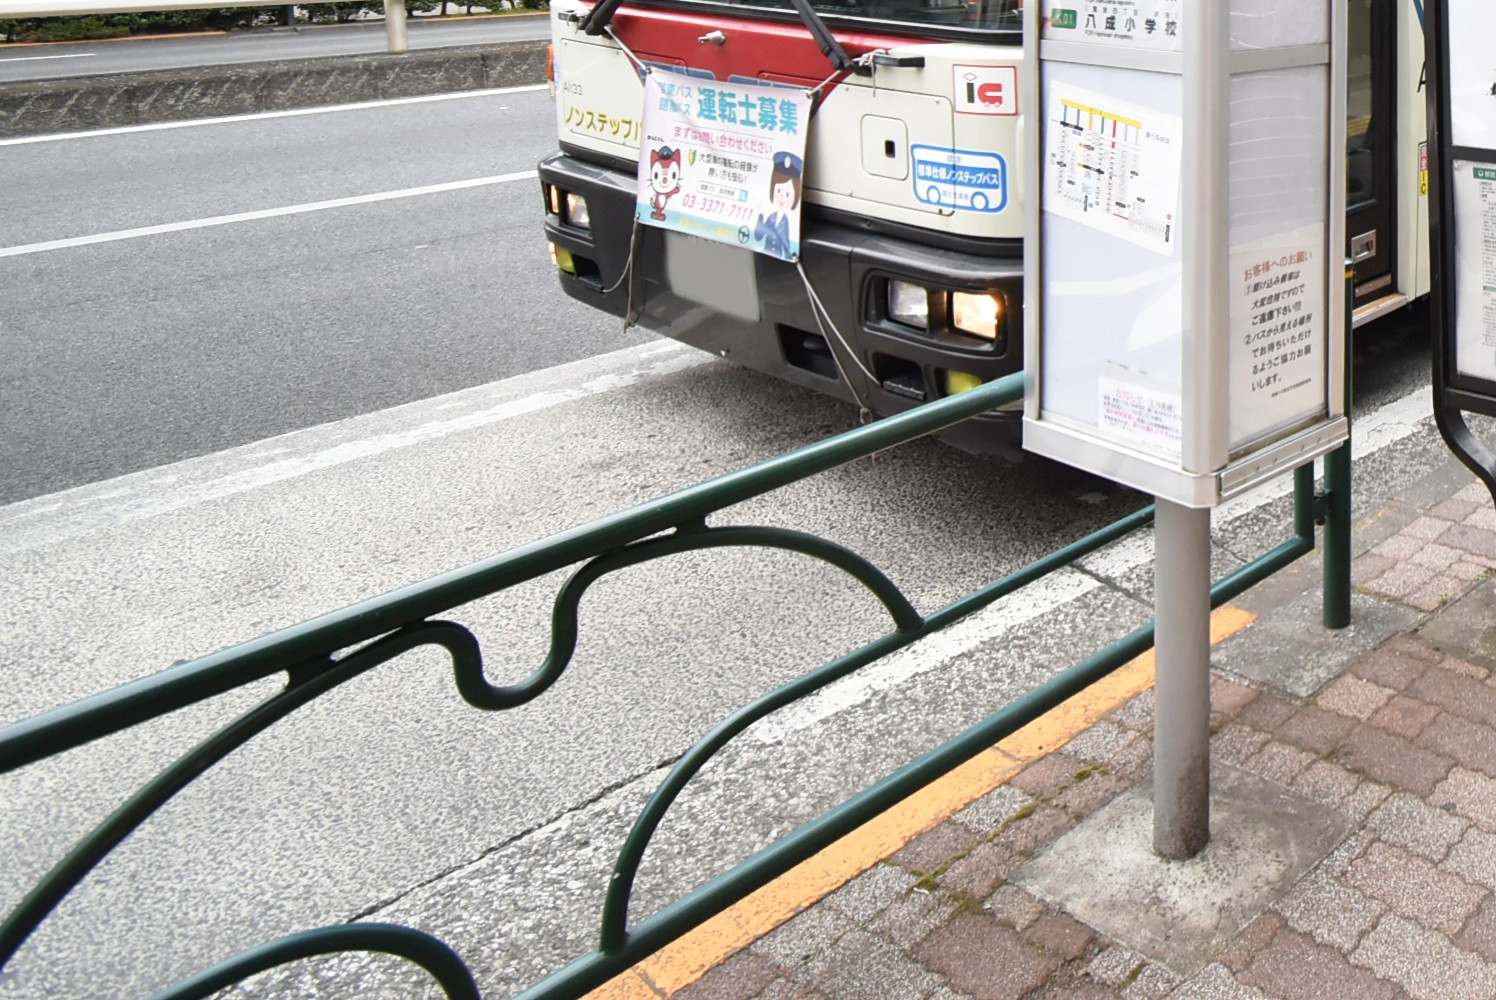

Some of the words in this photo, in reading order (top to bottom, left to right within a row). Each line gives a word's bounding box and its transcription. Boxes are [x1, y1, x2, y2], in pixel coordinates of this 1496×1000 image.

[1085, 14, 1177, 36] 八成小学校
[697, 86, 798, 135] 運転士募集
[917, 164, 999, 184] 標準仕様ノンステップバス
[1244, 251, 1312, 282] お客様へのお願い
[1252, 329, 1311, 358] でお待ちいただけ
[1252, 373, 1281, 391] いします。
